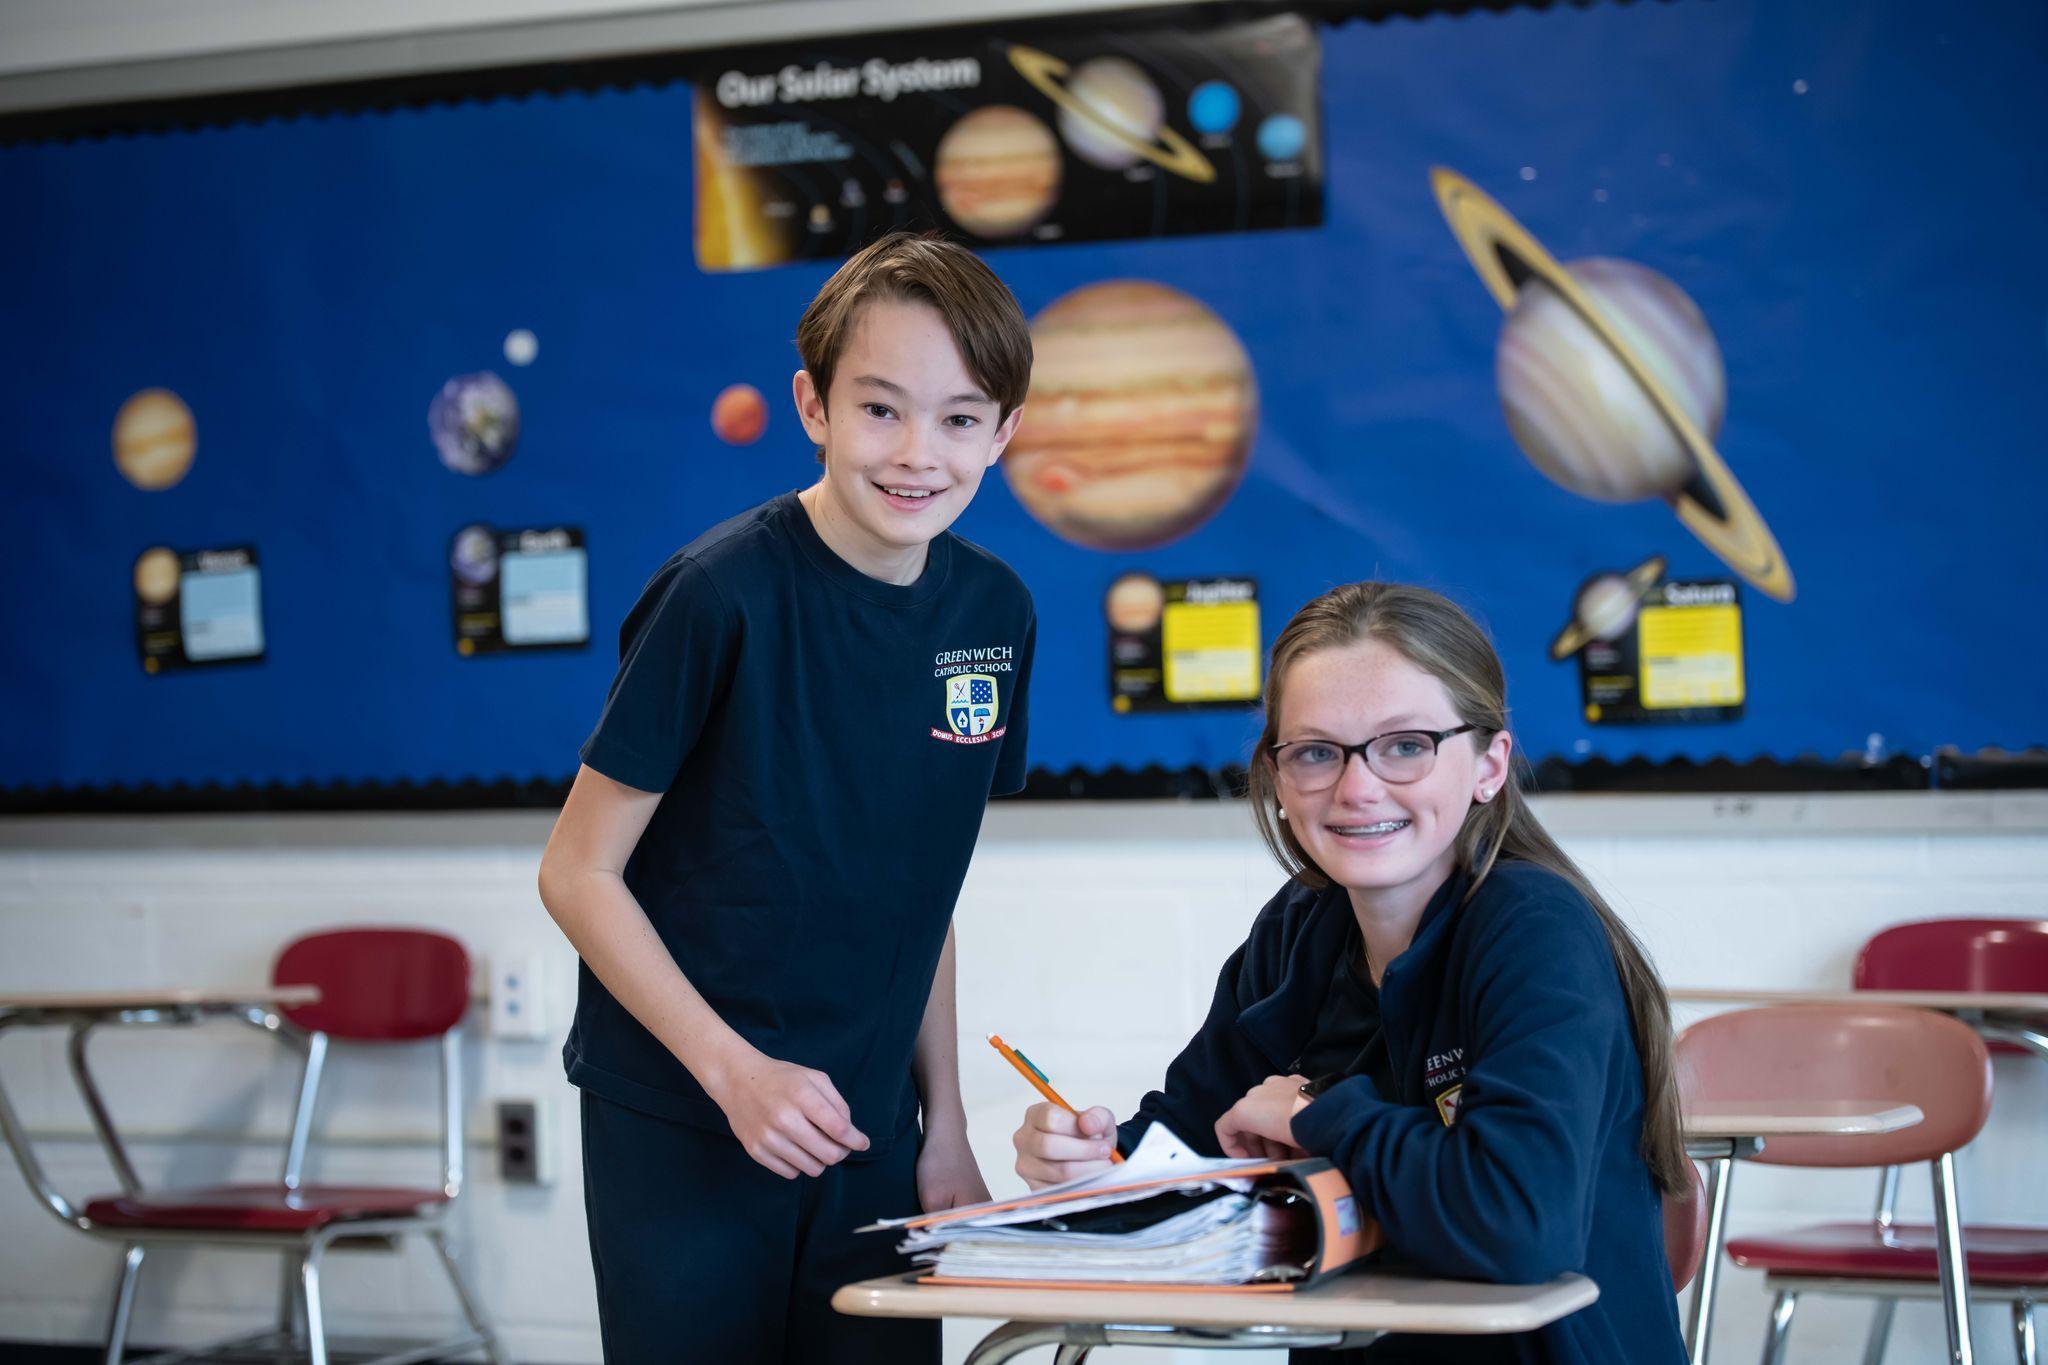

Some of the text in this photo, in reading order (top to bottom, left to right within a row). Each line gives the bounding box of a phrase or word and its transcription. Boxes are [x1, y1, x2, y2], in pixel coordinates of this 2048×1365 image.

[717, 58, 980, 107] Our Solar System
[1664, 583, 1735, 607] Saturn
[935, 646, 1013, 665] GREENWICH
[934, 662, 1012, 677] CATHOLIC SCHOOL
[956, 734, 988, 744] ECCLESIA
